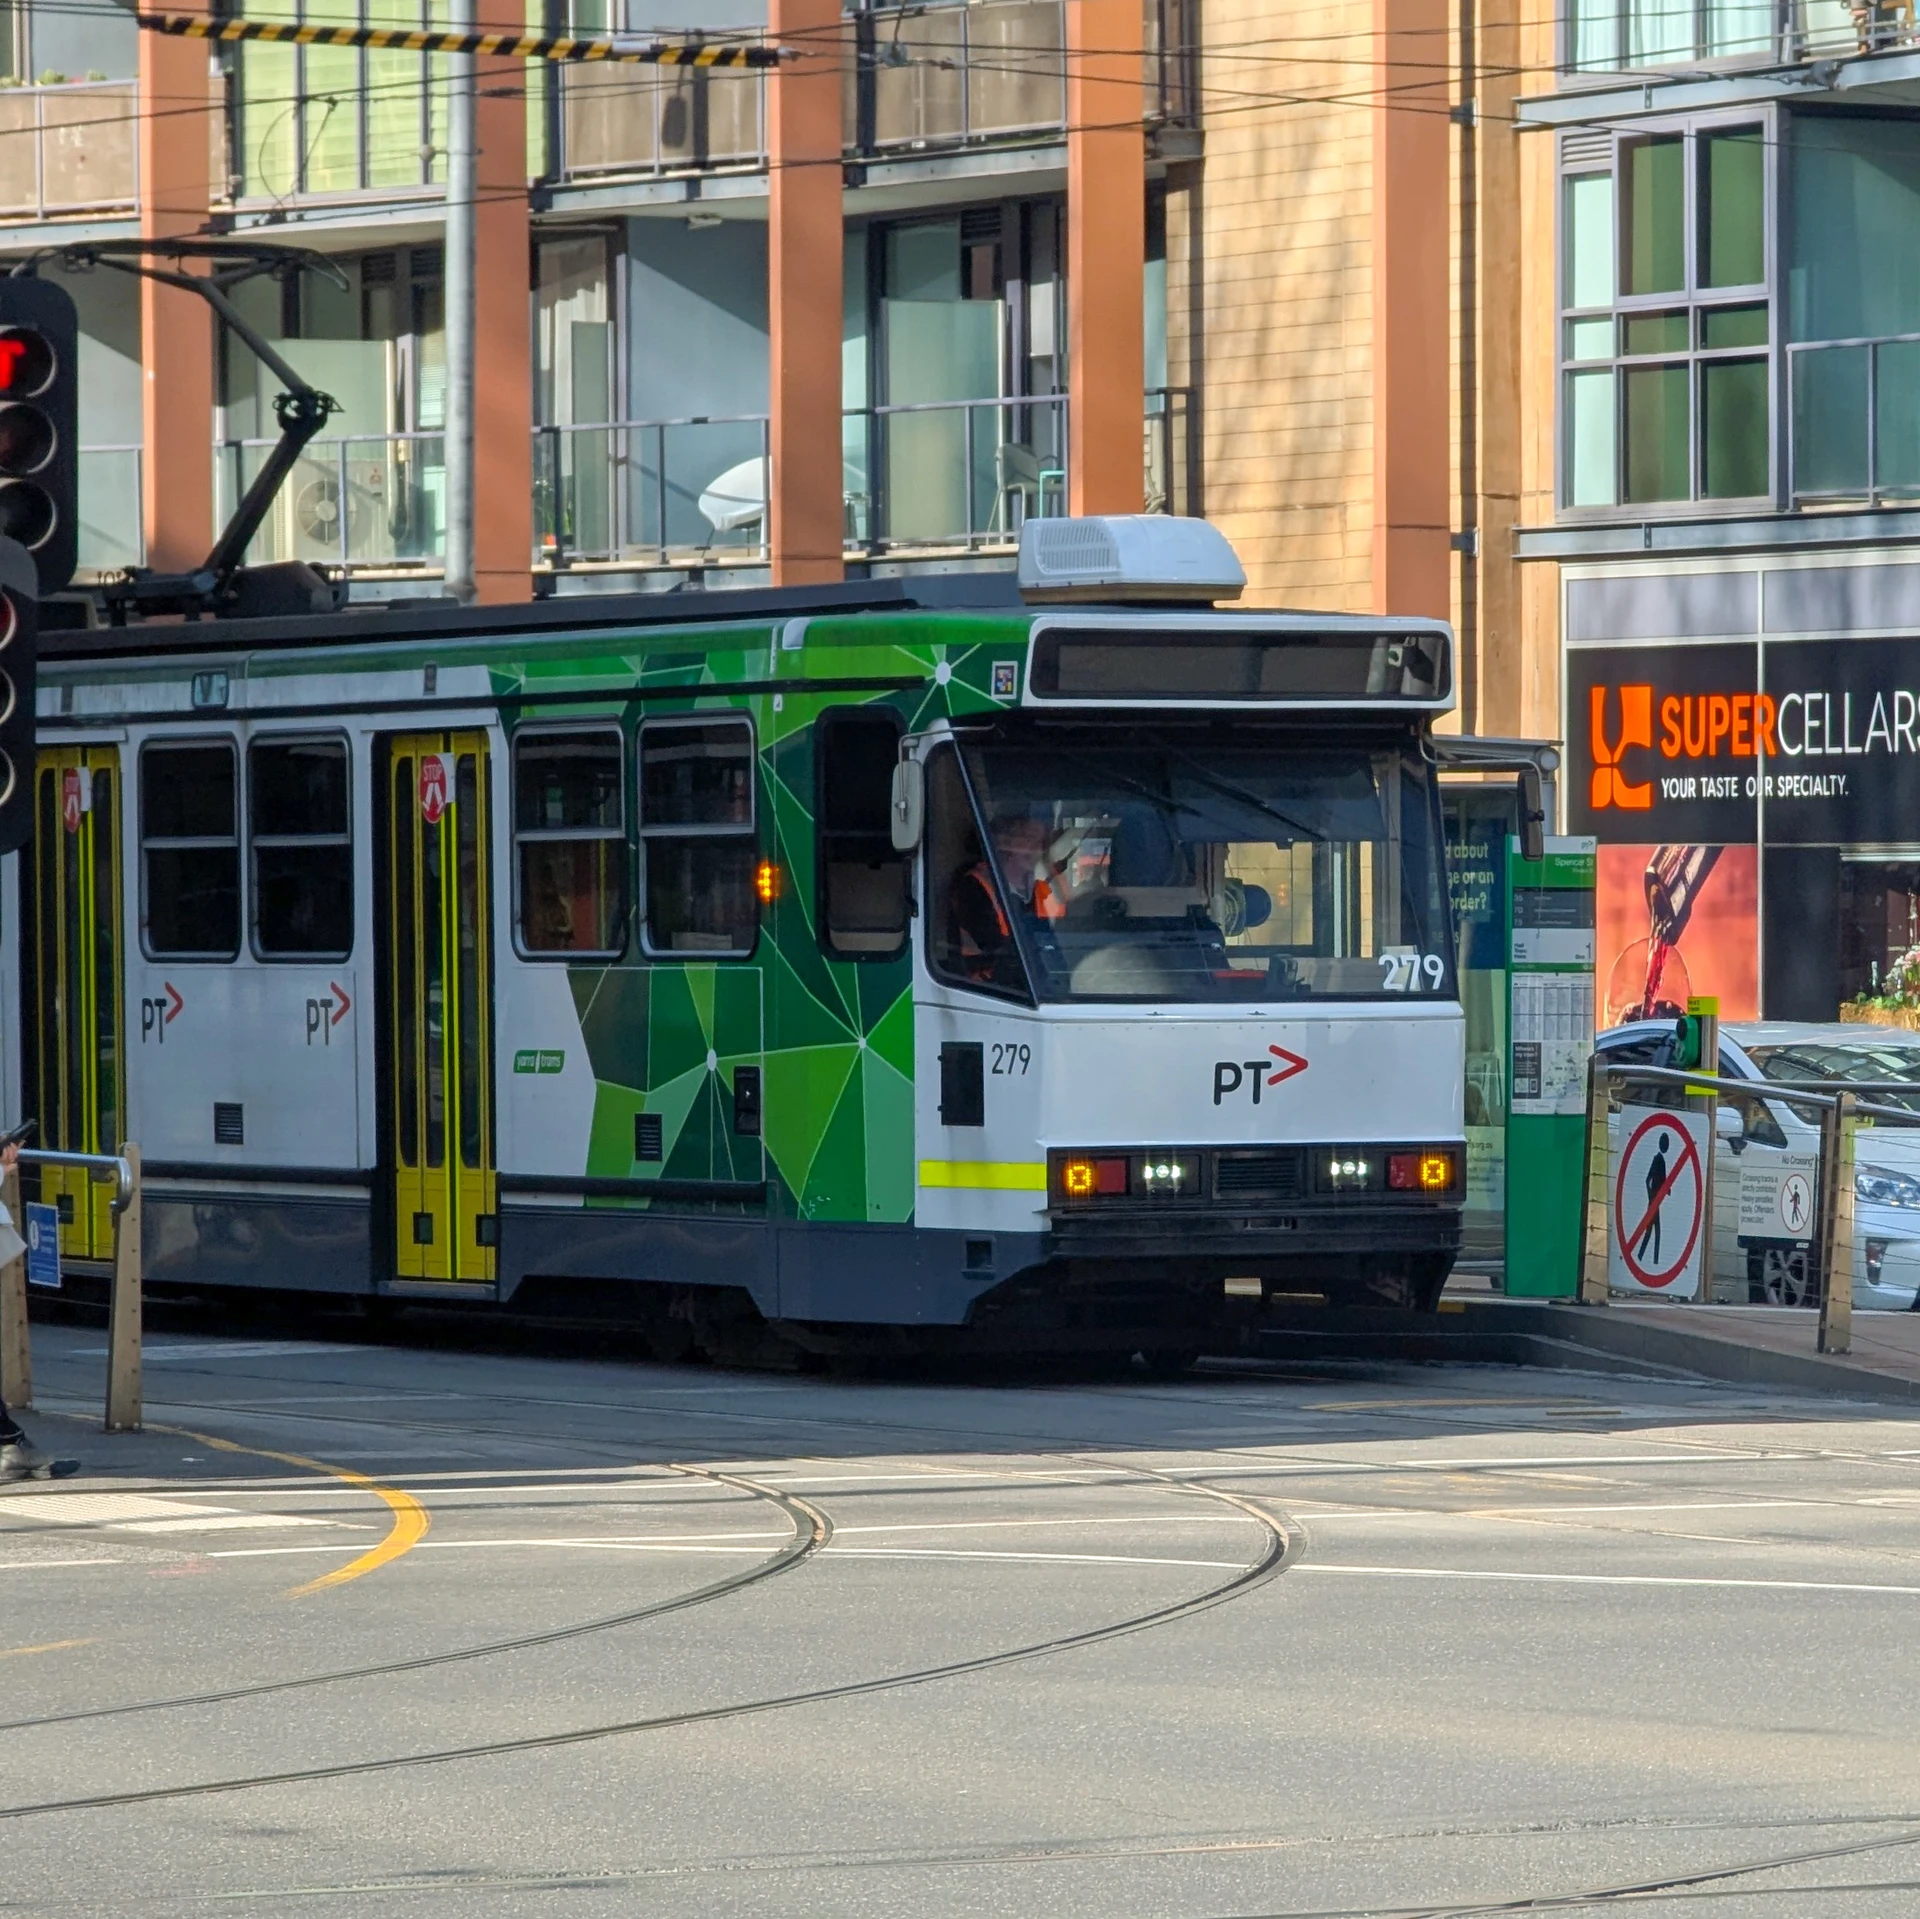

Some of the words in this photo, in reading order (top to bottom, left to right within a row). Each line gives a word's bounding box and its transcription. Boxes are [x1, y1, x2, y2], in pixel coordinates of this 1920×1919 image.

[423, 764, 443, 782] STOP
[1660, 776, 1697, 799] YOUR
[1700, 776, 1739, 798] TASTE
[1777, 774, 1849, 797] SPECIALTY.
[1454, 839, 1489, 859] about
[1462, 872, 1475, 884] or
[1478, 872, 1495, 884] an
[1378, 954, 1445, 990] 279
[991, 1043, 1031, 1076] 279
[1781, 1155, 1790, 1165] No
[1790, 1155, 1814, 1168] Crossing
